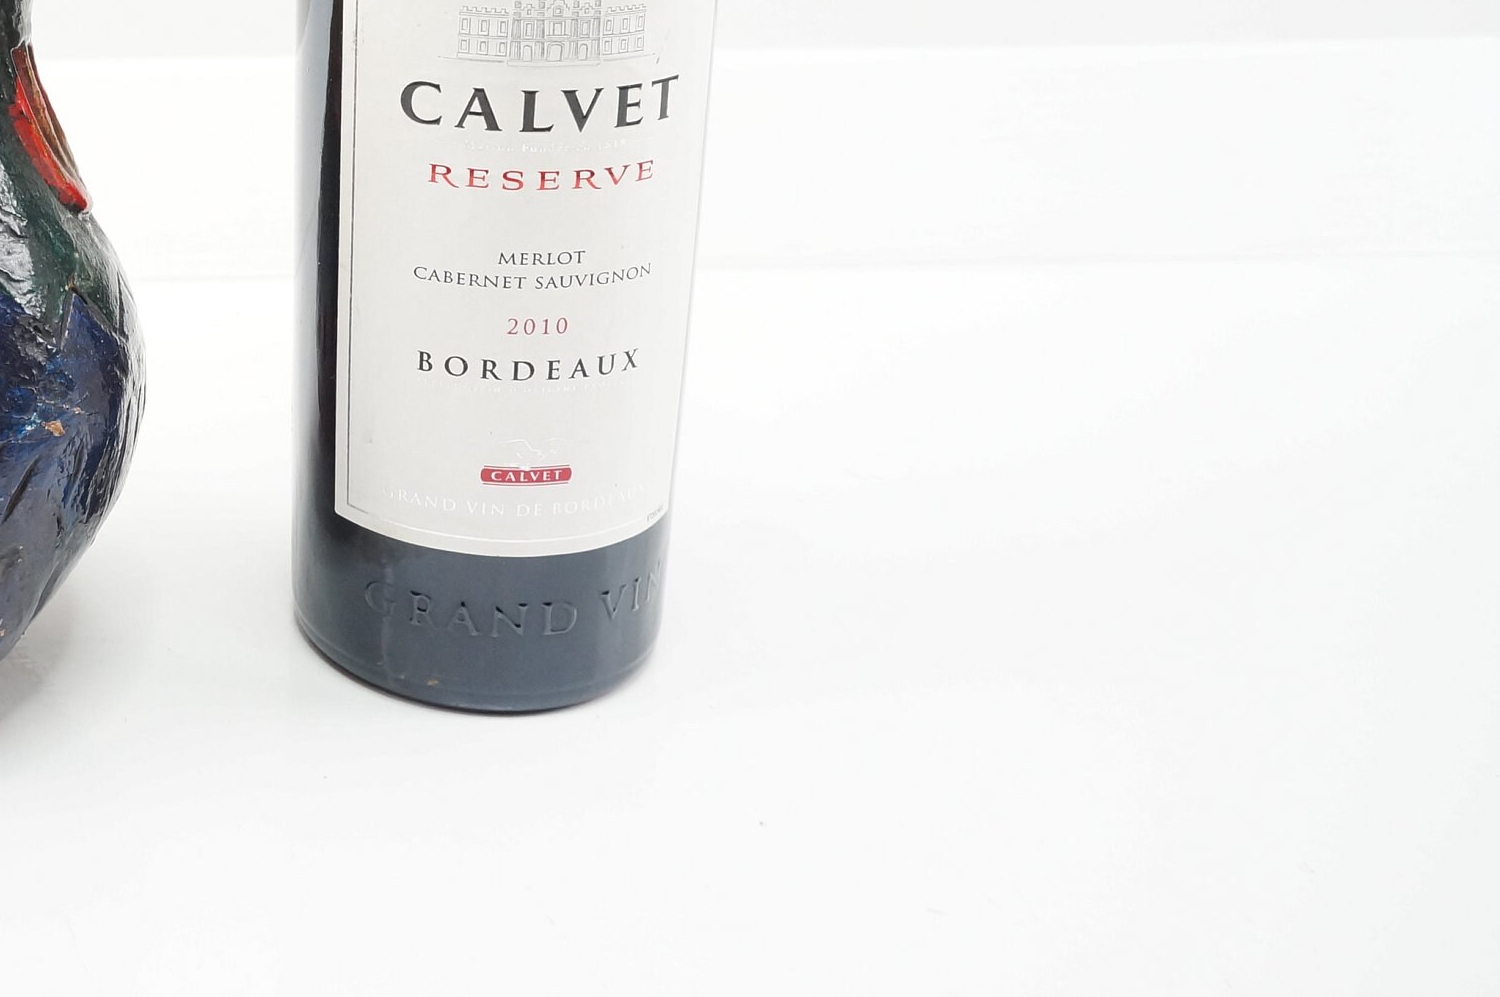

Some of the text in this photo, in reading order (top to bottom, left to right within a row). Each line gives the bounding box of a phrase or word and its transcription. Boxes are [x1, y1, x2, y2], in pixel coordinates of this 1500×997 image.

[400, 73, 680, 133] CALVET
[427, 159, 655, 192] RESERVE
[497, 250, 587, 266] MERLOT
[413, 262, 652, 290] CABERNET SAUVIGNON
[507, 316, 569, 336] 2010
[416, 347, 640, 382] BORDEAUX
[490, 470, 563, 482] CALVET
[466, 501, 505, 517] VIN
[516, 503, 543, 517] DE
[364, 578, 579, 638] GRAND
